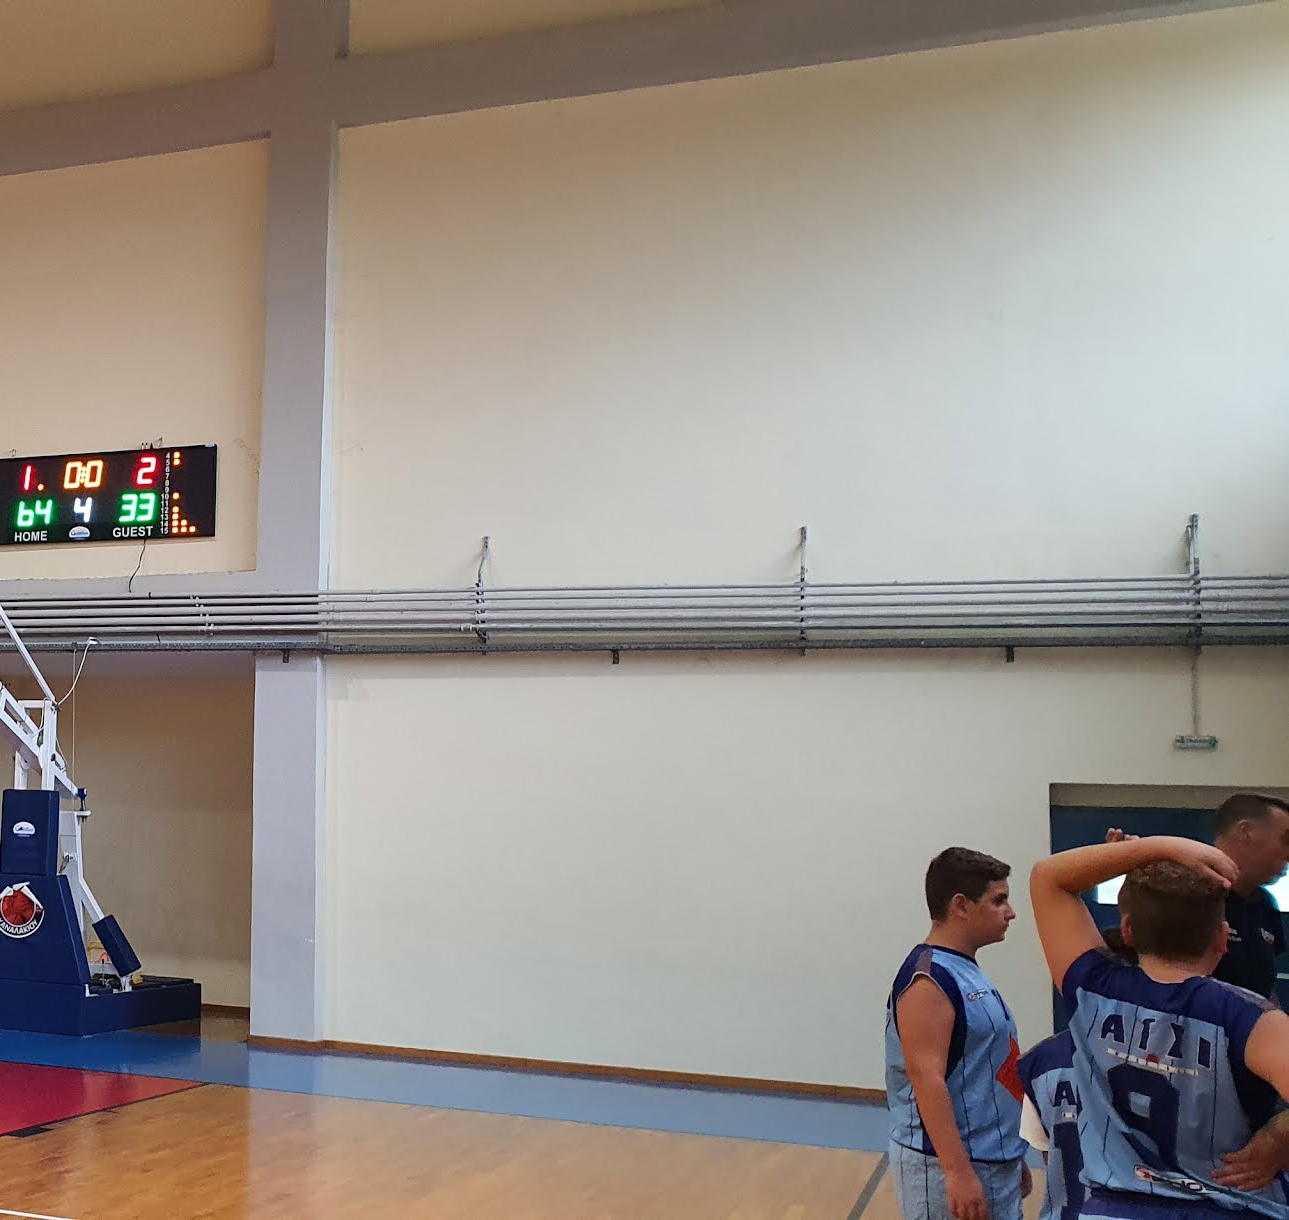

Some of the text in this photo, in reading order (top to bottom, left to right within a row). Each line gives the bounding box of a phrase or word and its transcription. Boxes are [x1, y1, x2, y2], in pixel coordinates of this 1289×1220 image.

[136, 456, 157, 485] 2
[16, 499, 53, 527] 64
[73, 496, 93, 523] 4
[118, 492, 157, 523] 33
[14, 531, 48, 542] HOME
[112, 526, 154, 538] GUEST
[1107, 1062, 1180, 1174] 9
